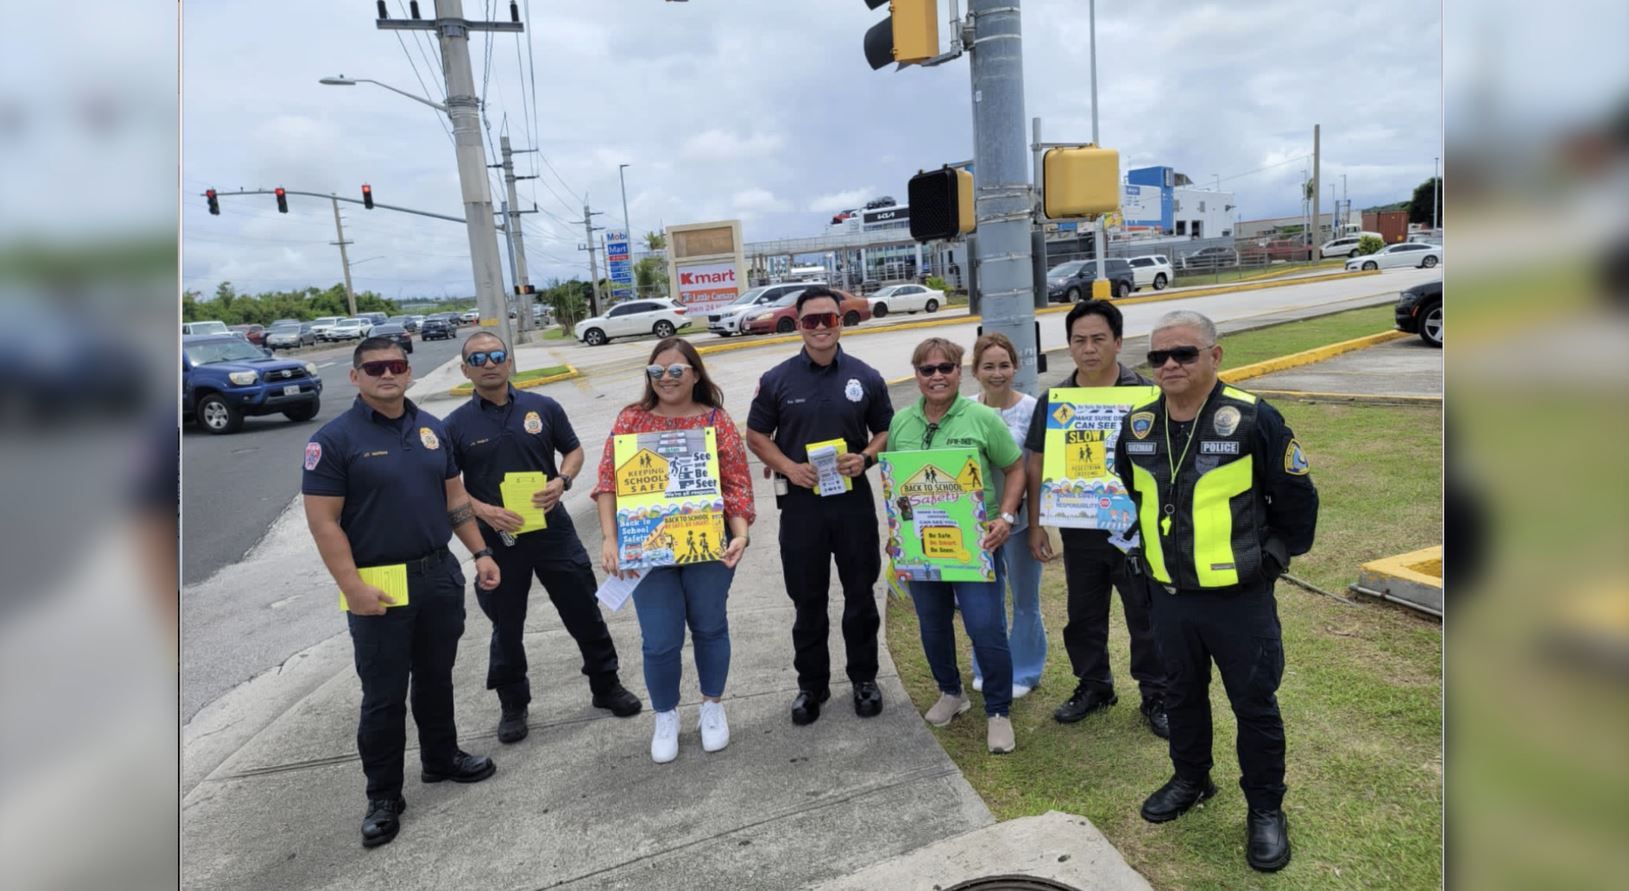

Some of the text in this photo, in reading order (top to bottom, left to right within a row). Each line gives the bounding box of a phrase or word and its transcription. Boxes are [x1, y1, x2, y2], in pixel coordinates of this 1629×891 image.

[607, 232, 629, 241] Mobi
[680, 269, 735, 285] Kmart
[1069, 430, 1101, 444] SLOW
[1203, 443, 1237, 452] POLICE
[693, 452, 711, 461] See
[627, 467, 665, 478] KEEPING
[695, 469, 708, 478] Be
[624, 474, 670, 486] SCHOOLS
[631, 482, 665, 493] SAFE
[904, 483, 963, 492] BACK TO SCHOOL
[909, 492, 960, 506] Safety
[622, 526, 649, 535] School
